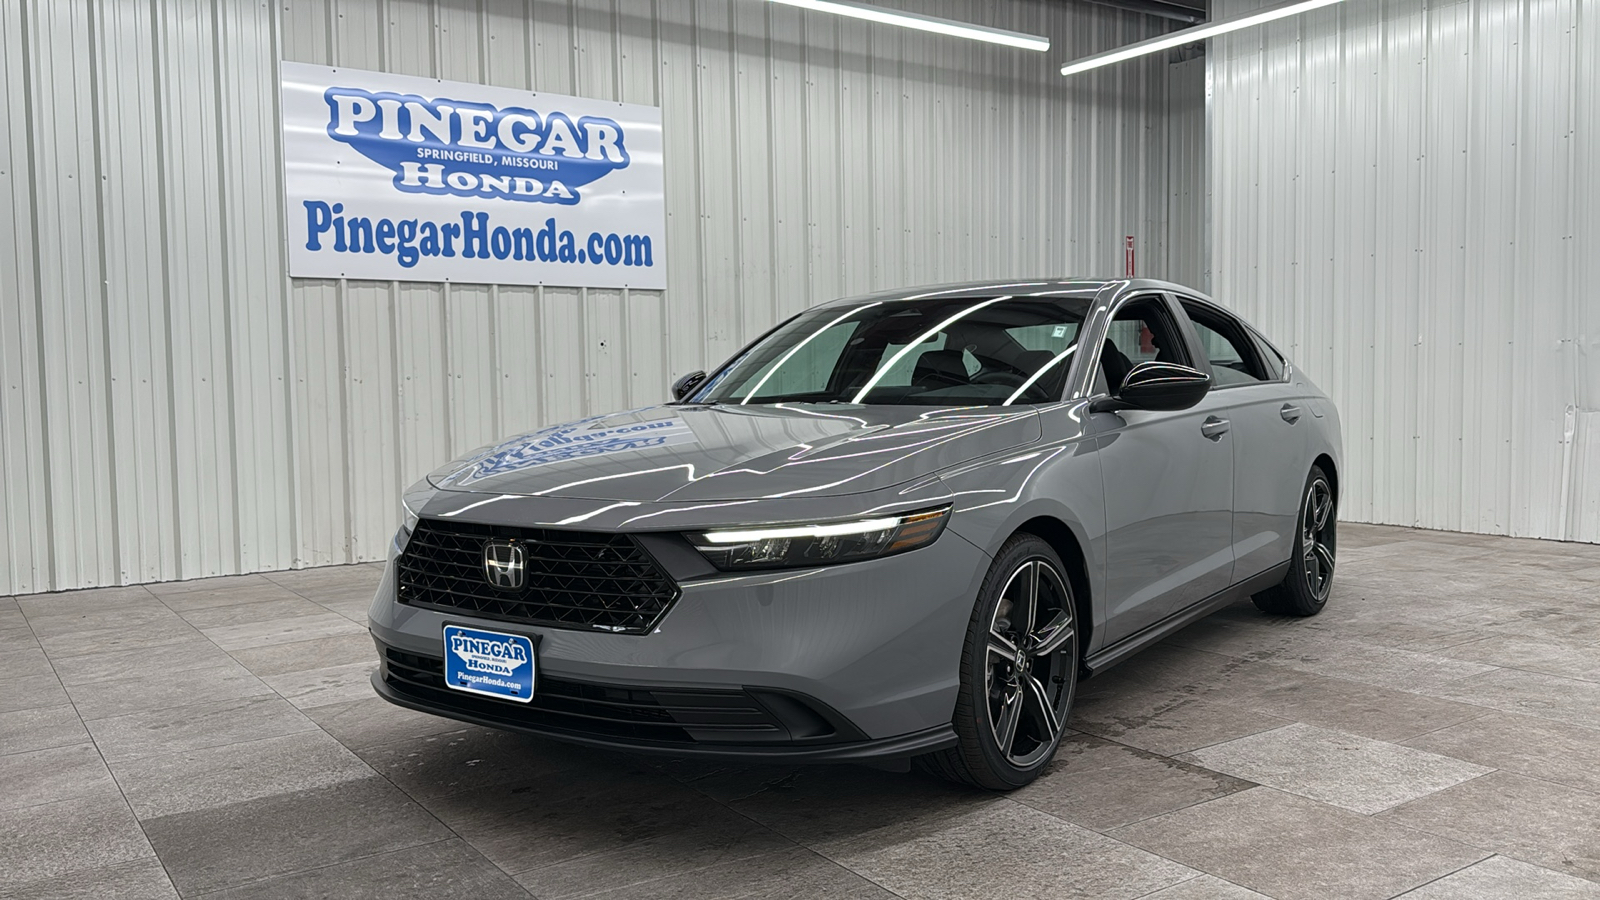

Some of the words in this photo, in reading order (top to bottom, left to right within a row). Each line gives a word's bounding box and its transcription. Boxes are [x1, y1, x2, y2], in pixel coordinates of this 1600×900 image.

[331, 94, 626, 163] PINEGAR
[416, 147, 498, 167] SPRINGFIELD,
[501, 155, 559, 171] MISSOURI
[400, 161, 575, 199] HONDA
[303, 200, 654, 268] PinegarHonda.com
[453, 638, 525, 661] PINEGAR
[468, 659, 510, 674] HONDA
[457, 671, 521, 689] PinegarHonda.com
